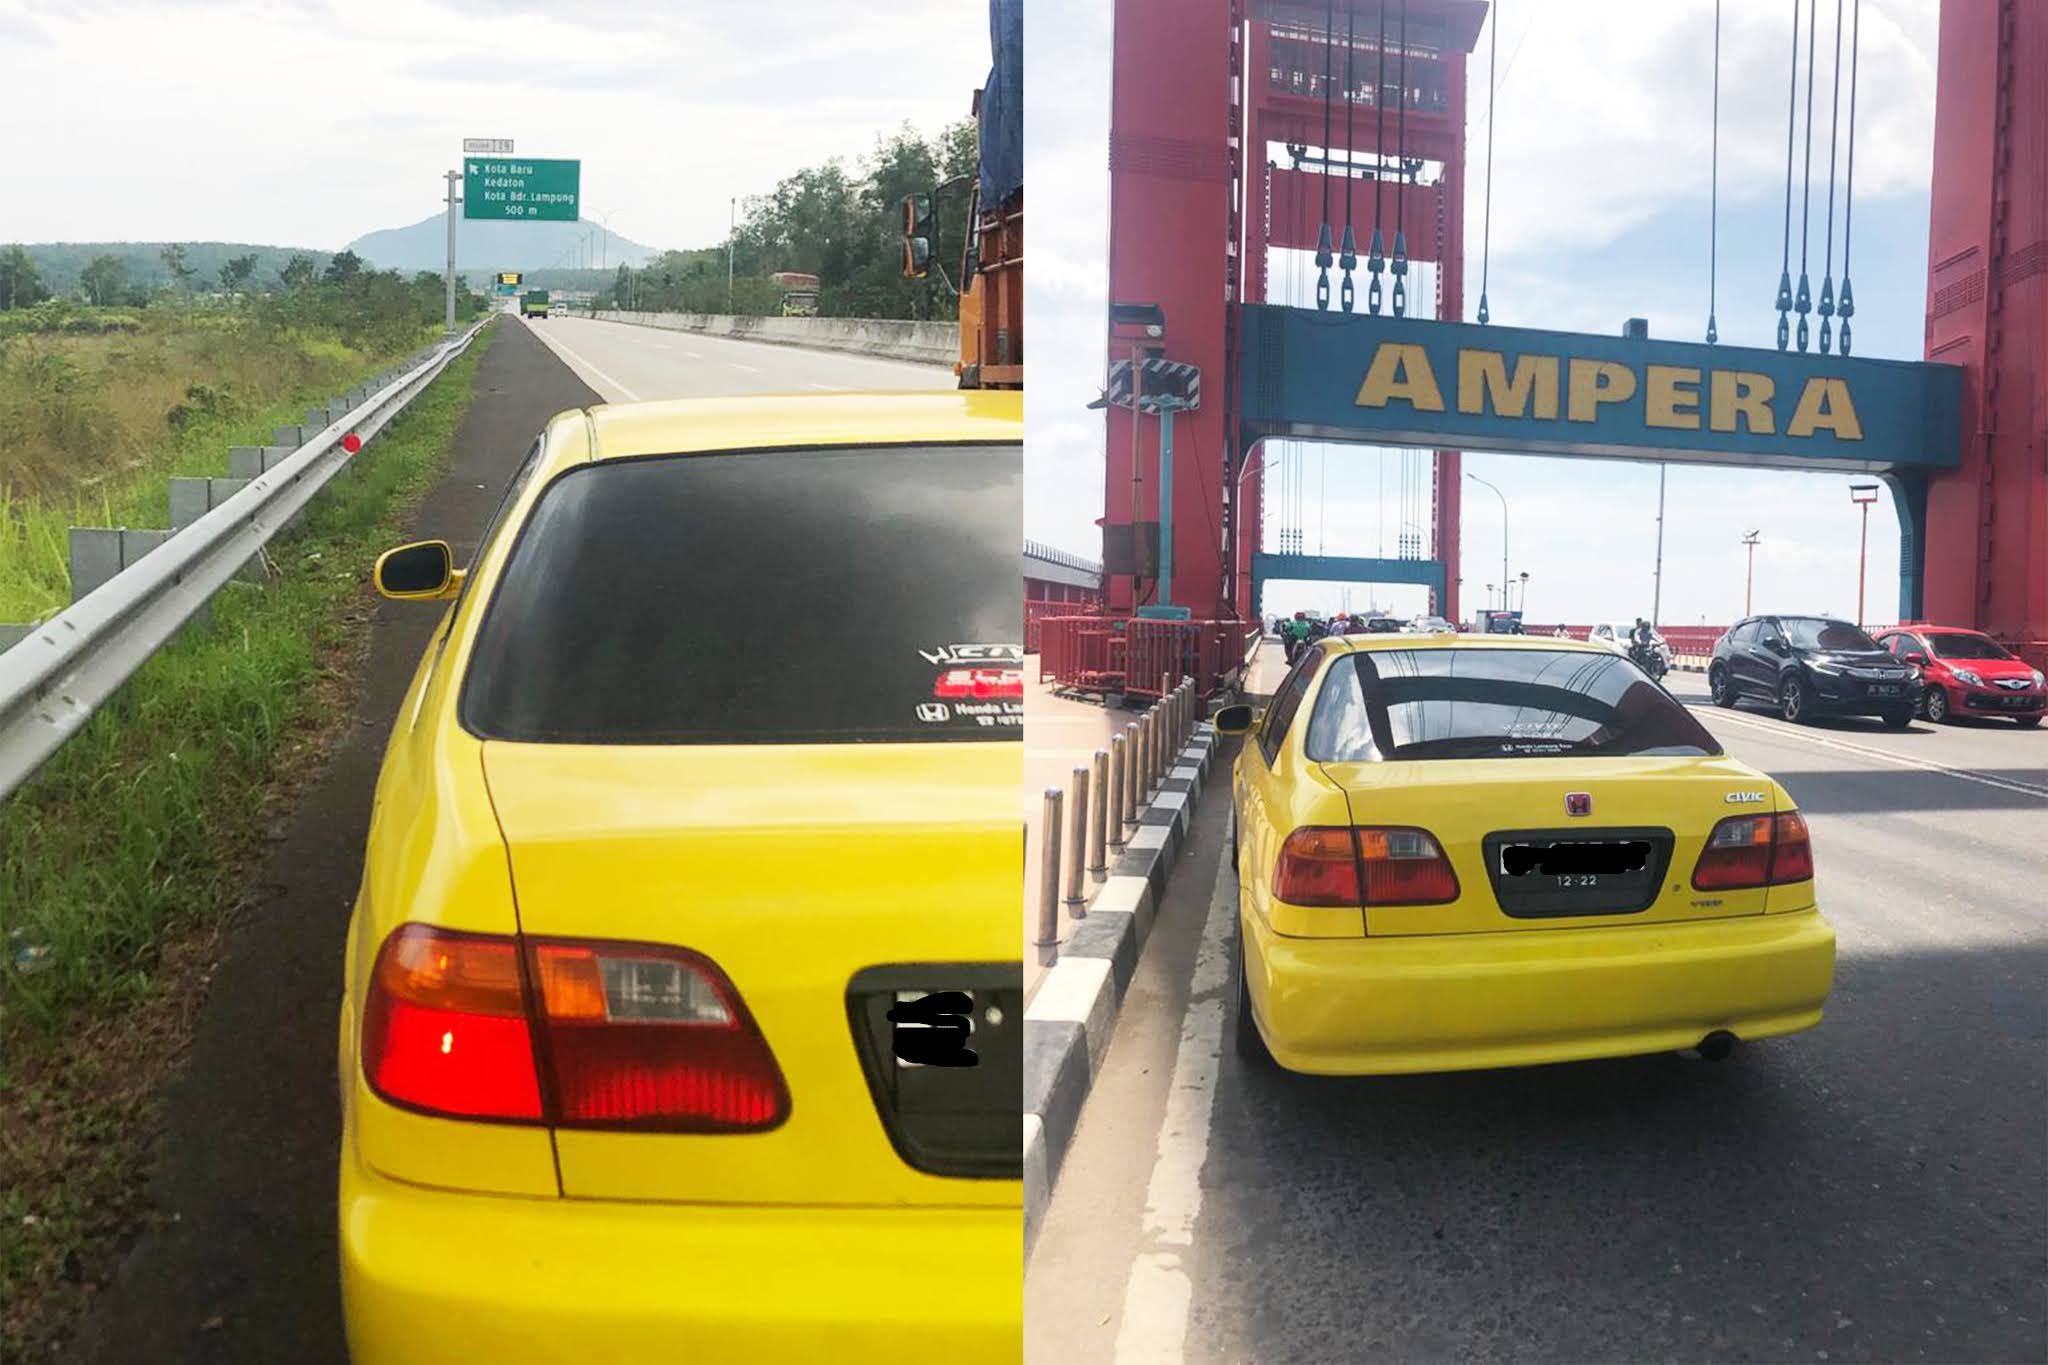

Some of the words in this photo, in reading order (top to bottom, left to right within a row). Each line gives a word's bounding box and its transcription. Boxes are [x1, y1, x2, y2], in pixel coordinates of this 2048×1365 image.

[484, 165, 506, 174] Kota
[510, 165, 533, 174] Baru
[484, 178, 525, 187] Kedaton
[484, 191, 506, 201] Kota
[505, 206, 523, 215] 500
[528, 207, 537, 215] m
[1354, 343, 1865, 441] AMPERA
[1725, 791, 1766, 803] CIVIC
